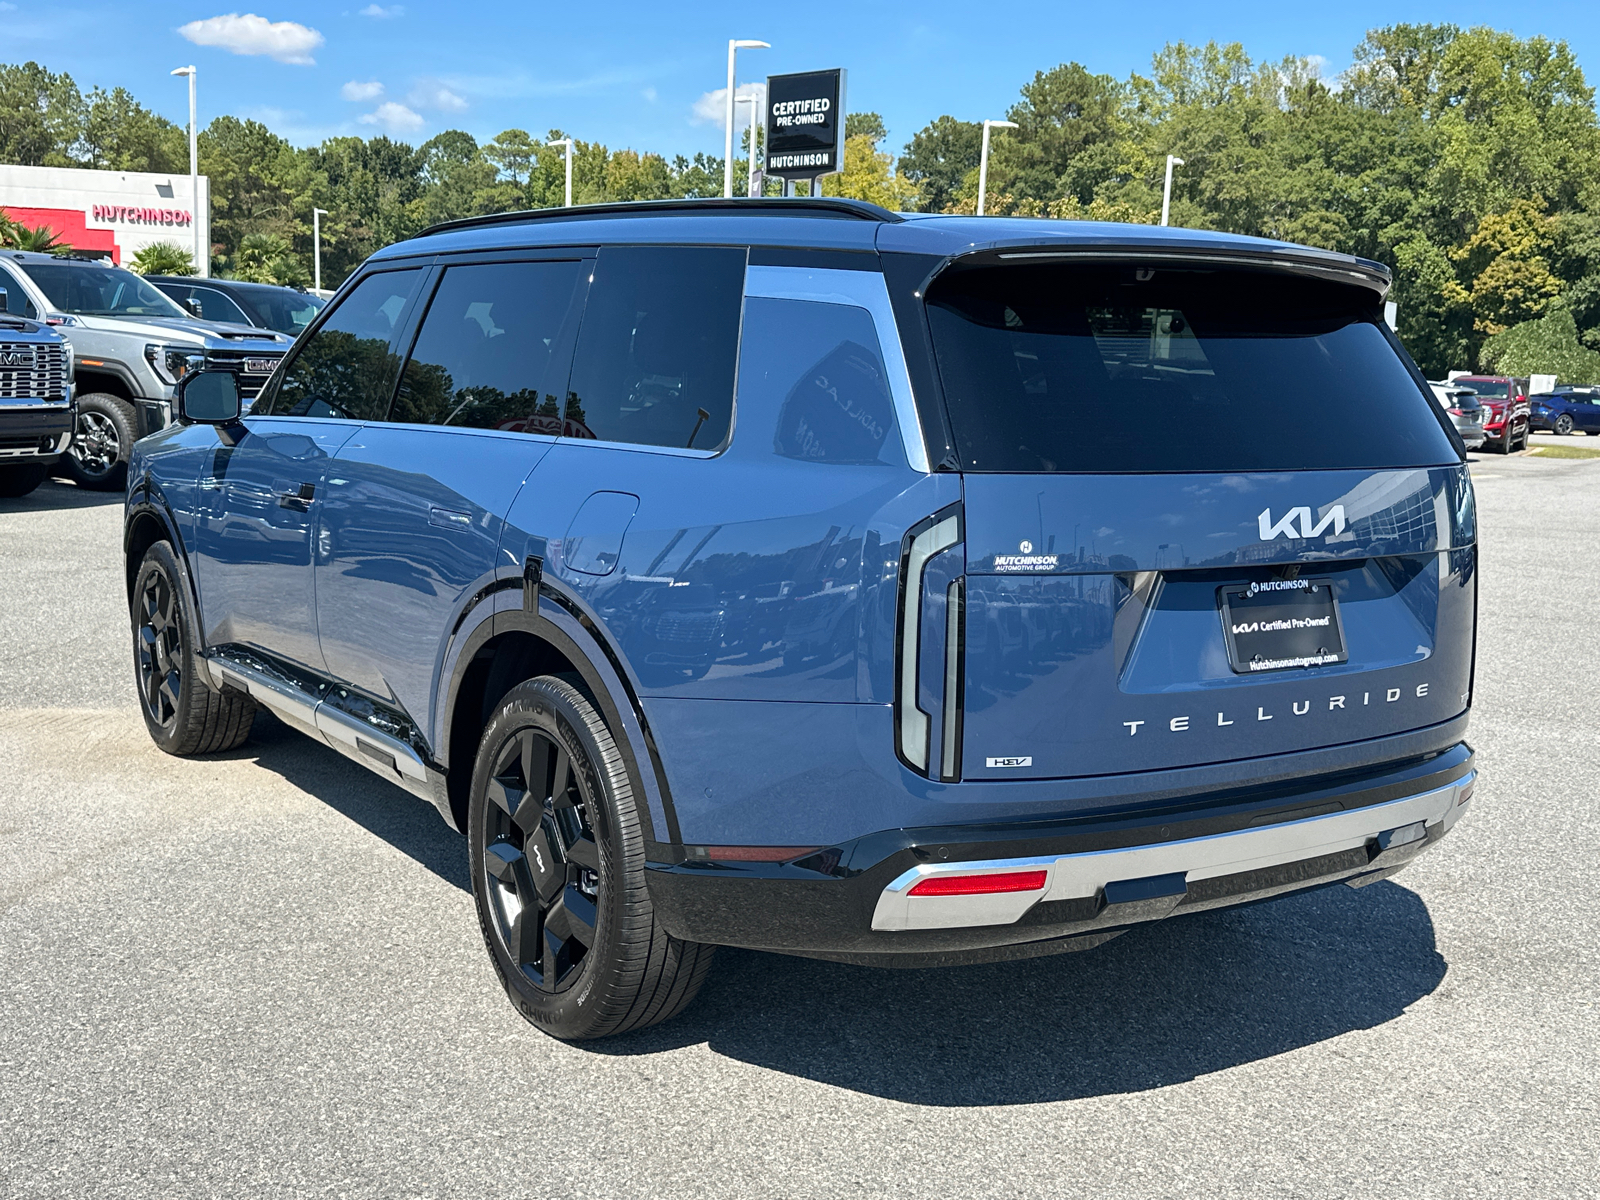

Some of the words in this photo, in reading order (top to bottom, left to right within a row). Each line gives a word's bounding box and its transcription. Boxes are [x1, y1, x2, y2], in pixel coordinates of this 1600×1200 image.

[772, 98, 830, 116] CERTIFIED
[776, 113, 825, 127] PRE-OWNED
[770, 153, 829, 168] HUTCHINSON
[1258, 504, 1346, 541] KIA
[995, 555, 1059, 566] HUTCHINSON
[995, 564, 1034, 573] AUTOMOTIVE
[1034, 564, 1055, 572] GROUP
[1260, 579, 1309, 592] HUTCHINSON
[1232, 622, 1259, 634] KIA
[1260, 619, 1292, 632] Certified
[1249, 654, 1339, 671] Hutchinsonautogroup.com
[1122, 682, 1430, 736] TELLURIDE
[994, 757, 1028, 767] HEV
